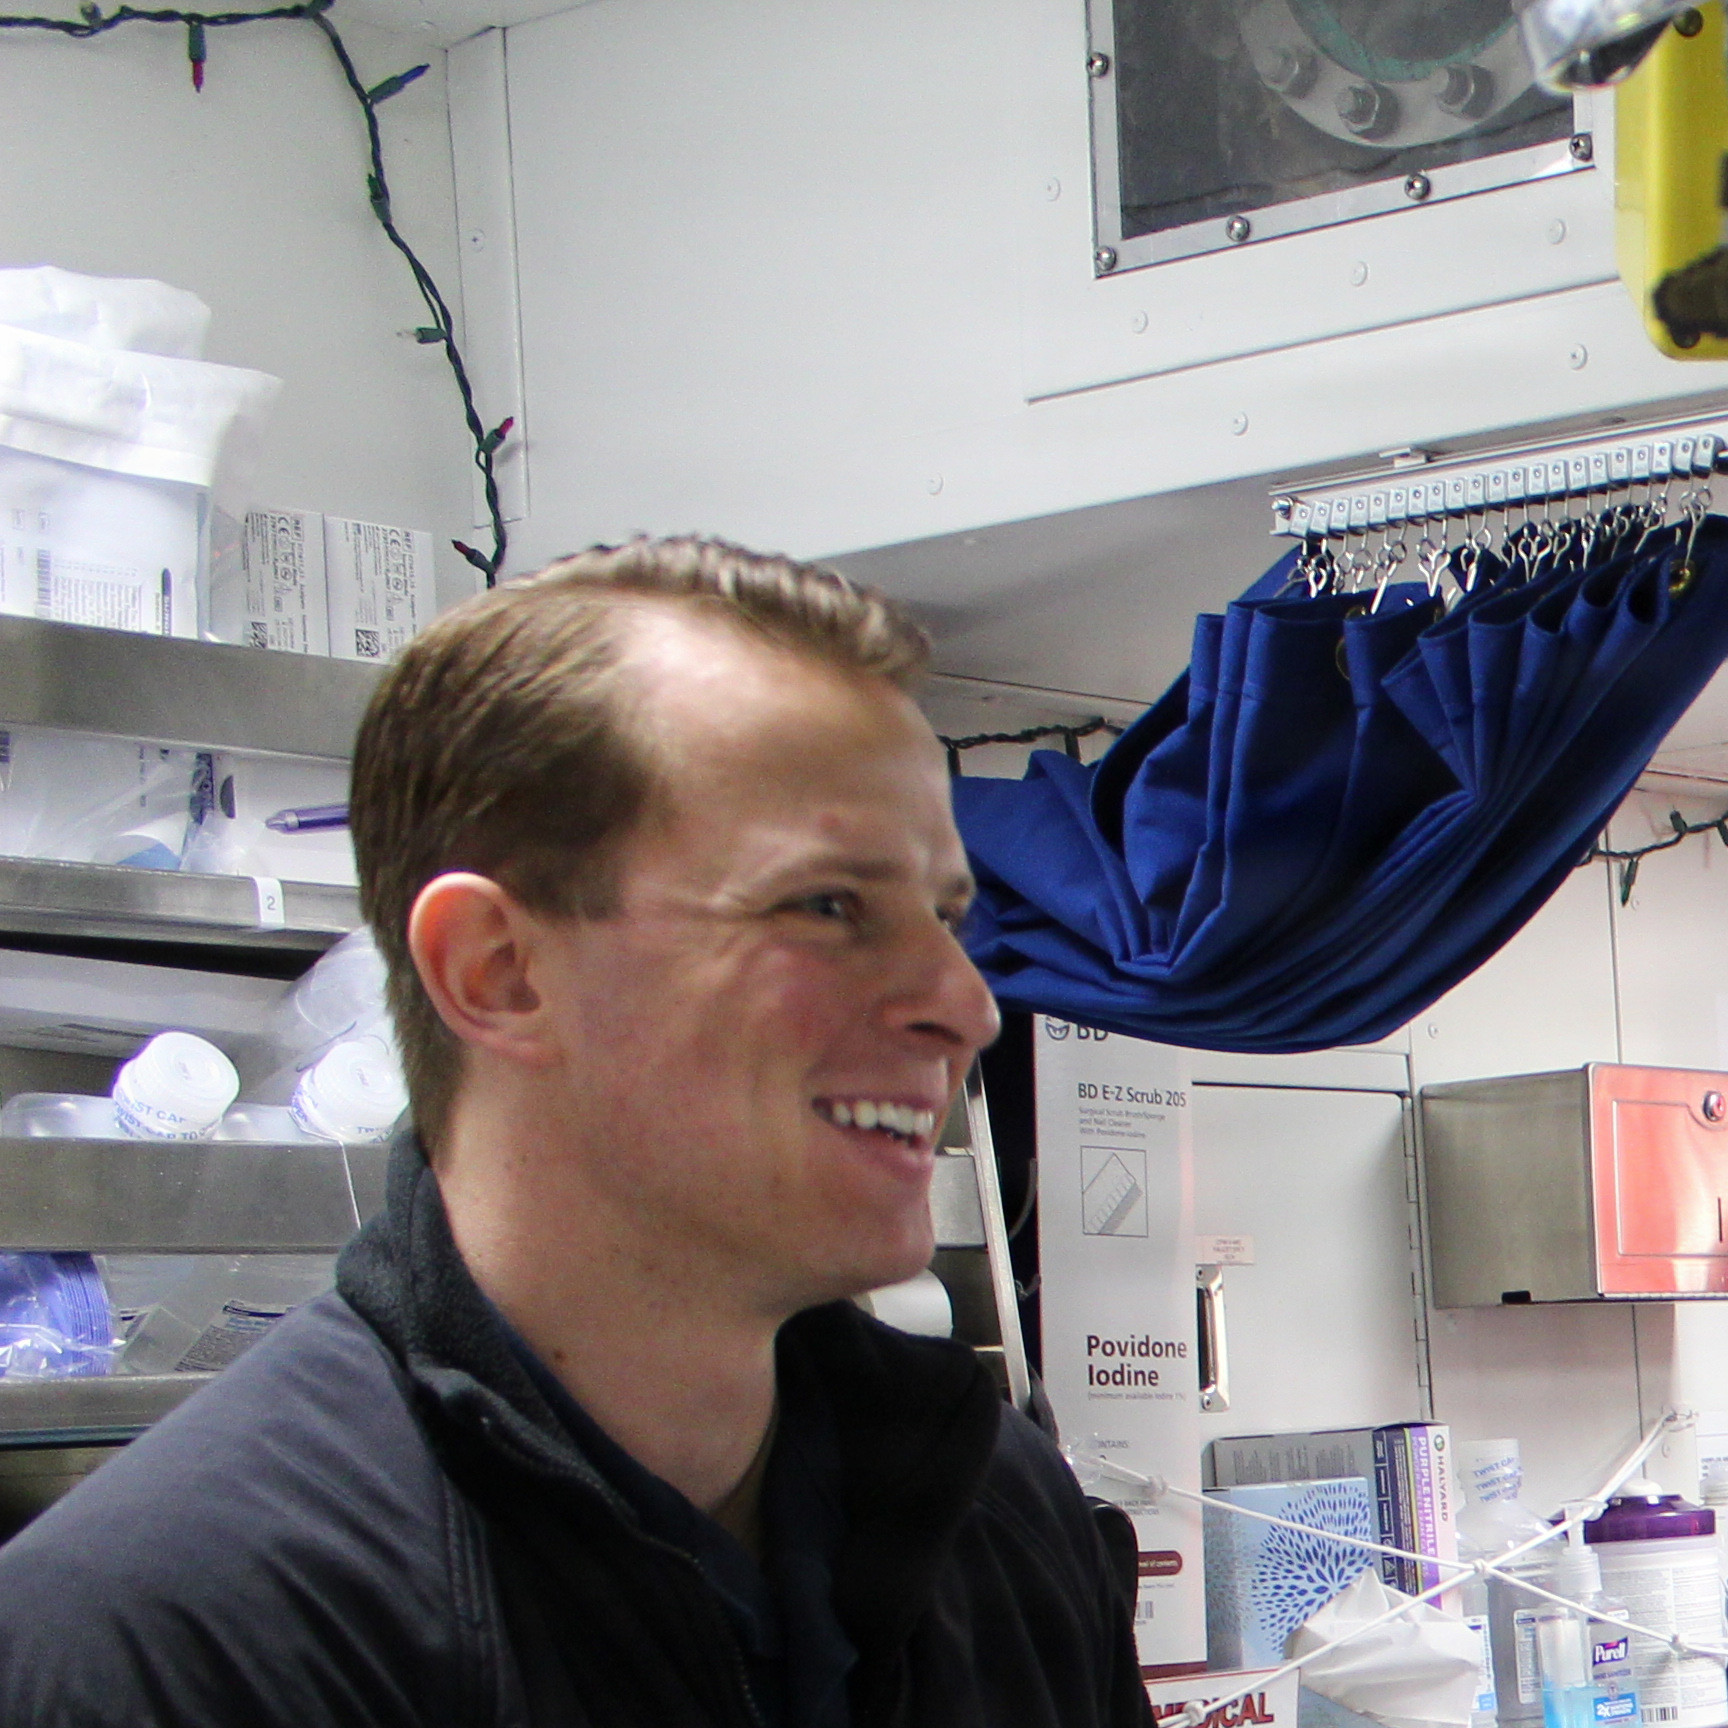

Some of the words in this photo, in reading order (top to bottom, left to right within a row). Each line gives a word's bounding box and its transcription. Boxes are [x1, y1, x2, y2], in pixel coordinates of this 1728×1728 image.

[266, 895, 277, 911] 2
[1078, 1082, 1098, 1099] BD
[1102, 1085, 1122, 1101] E-Z
[1127, 1086, 1163, 1105] Scrub
[1165, 1090, 1187, 1107] 205
[1086, 1334, 1188, 1358] Povidone
[1088, 1363, 1160, 1387] Iodine
[1437, 1456, 1449, 1522] HALYARD
[1595, 1643, 1626, 1663] Purell
